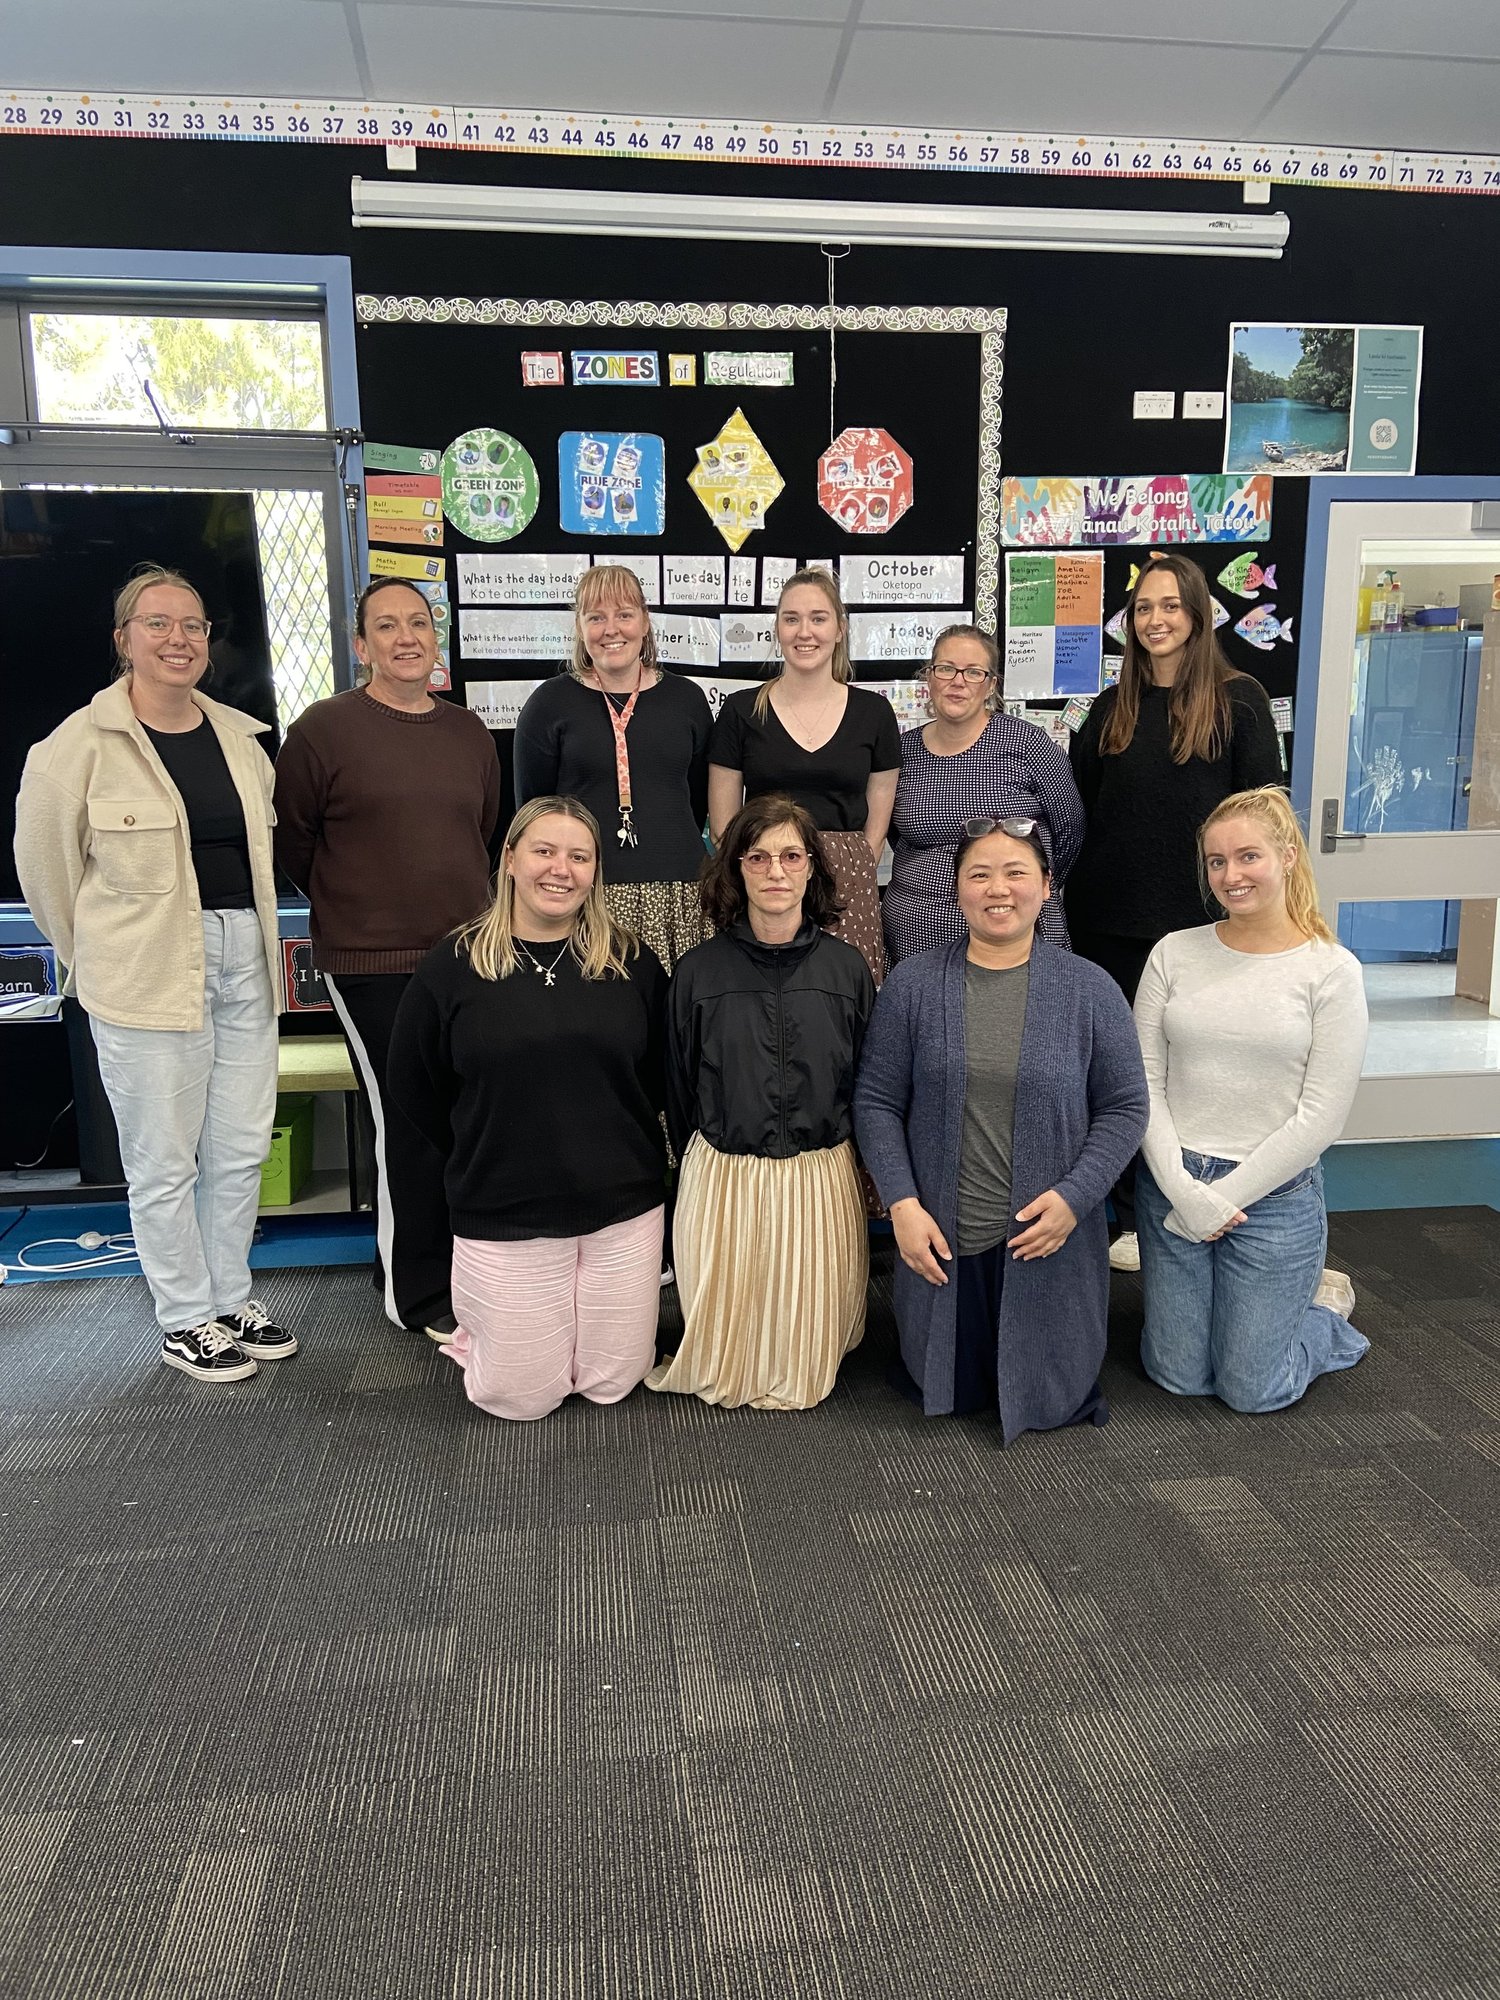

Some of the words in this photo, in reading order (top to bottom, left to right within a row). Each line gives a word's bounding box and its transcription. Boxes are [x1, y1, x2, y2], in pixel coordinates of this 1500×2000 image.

[3, 106, 27, 124] 28
[40, 108, 63, 125] 29
[76, 109, 99, 126] 30
[113, 110, 132, 128] 31
[147, 112, 170, 129] 32
[183, 113, 205, 130] 33
[217, 114, 241, 131] 34
[252, 115, 275, 132] 35
[287, 116, 310, 133] 36
[322, 117, 344, 134] 37
[357, 118, 379, 135] 38
[391, 120, 413, 136] 39
[425, 122, 448, 139] 40
[462, 124, 480, 141] 41
[494, 125, 516, 143] 42
[527, 127, 549, 144] 43
[561, 128, 583, 146] 44
[594, 130, 616, 147] 45
[627, 132, 649, 149] 46
[660, 133, 682, 150] 47
[693, 135, 714, 152] 48
[725, 136, 747, 153] 49
[758, 138, 779, 155] 50
[792, 140, 808, 156] 51
[822, 141, 842, 157] 52
[853, 142, 874, 158] 53
[885, 143, 906, 159] 54
[917, 144, 937, 161] 55
[948, 146, 968, 162] 56
[979, 147, 1000, 163] 57
[1010, 148, 1030, 164] 58
[1041, 149, 1061, 165] 59
[1071, 151, 1092, 167] 60
[1103, 152, 1120, 168] 61
[1132, 153, 1152, 169] 62
[1163, 154, 1182, 169] 63
[1193, 155, 1213, 171] 64
[1223, 157, 1242, 172] 65
[1253, 158, 1272, 174] 66
[1282, 160, 1301, 176] 67
[1310, 162, 1329, 178] 68
[1339, 164, 1358, 179] 69
[1368, 165, 1387, 181] 70
[1399, 167, 1414, 183] 71
[1426, 168, 1444, 184] 72
[1455, 169, 1473, 185] 73
[1483, 171, 1500, 186] 74
[528, 363, 554, 380] The
[576, 356, 654, 379] ZONES
[674, 363, 689, 380] of
[370, 449, 398, 460] Singing
[1089, 488, 1118, 506] We
[1126, 487, 1189, 509] Belong
[375, 524, 397, 532] Morning
[1136, 514, 1198, 532] Kotahi
[1204, 515, 1255, 531] Tātou
[868, 560, 935, 579] October
[463, 573, 491, 585] What
[494, 573, 503, 584] is
[507, 573, 525, 584] the
[528, 573, 546, 586] day
[666, 568, 722, 587] Tuesday
[732, 574, 752, 588] the
[766, 577, 788, 589] 15t
[882, 580, 922, 591] Oketopa
[470, 589, 487, 600] Ko
[488, 589, 501, 600] te
[503, 588, 527, 599] aha
[530, 588, 559, 599] tenei
[734, 590, 748, 602] te
[655, 630, 683, 644] ther
[889, 622, 934, 641] today
[462, 633, 482, 643] What
[484, 634, 491, 642] is
[492, 634, 505, 643] the
[508, 633, 539, 643] weather
[541, 634, 561, 644] doing
[1008, 638, 1034, 648] Abigail
[485, 647, 493, 655] te
[508, 647, 516, 655] te
[469, 704, 491, 713] What
[501, 704, 515, 713] the
[0, 981, 33, 993] earn
